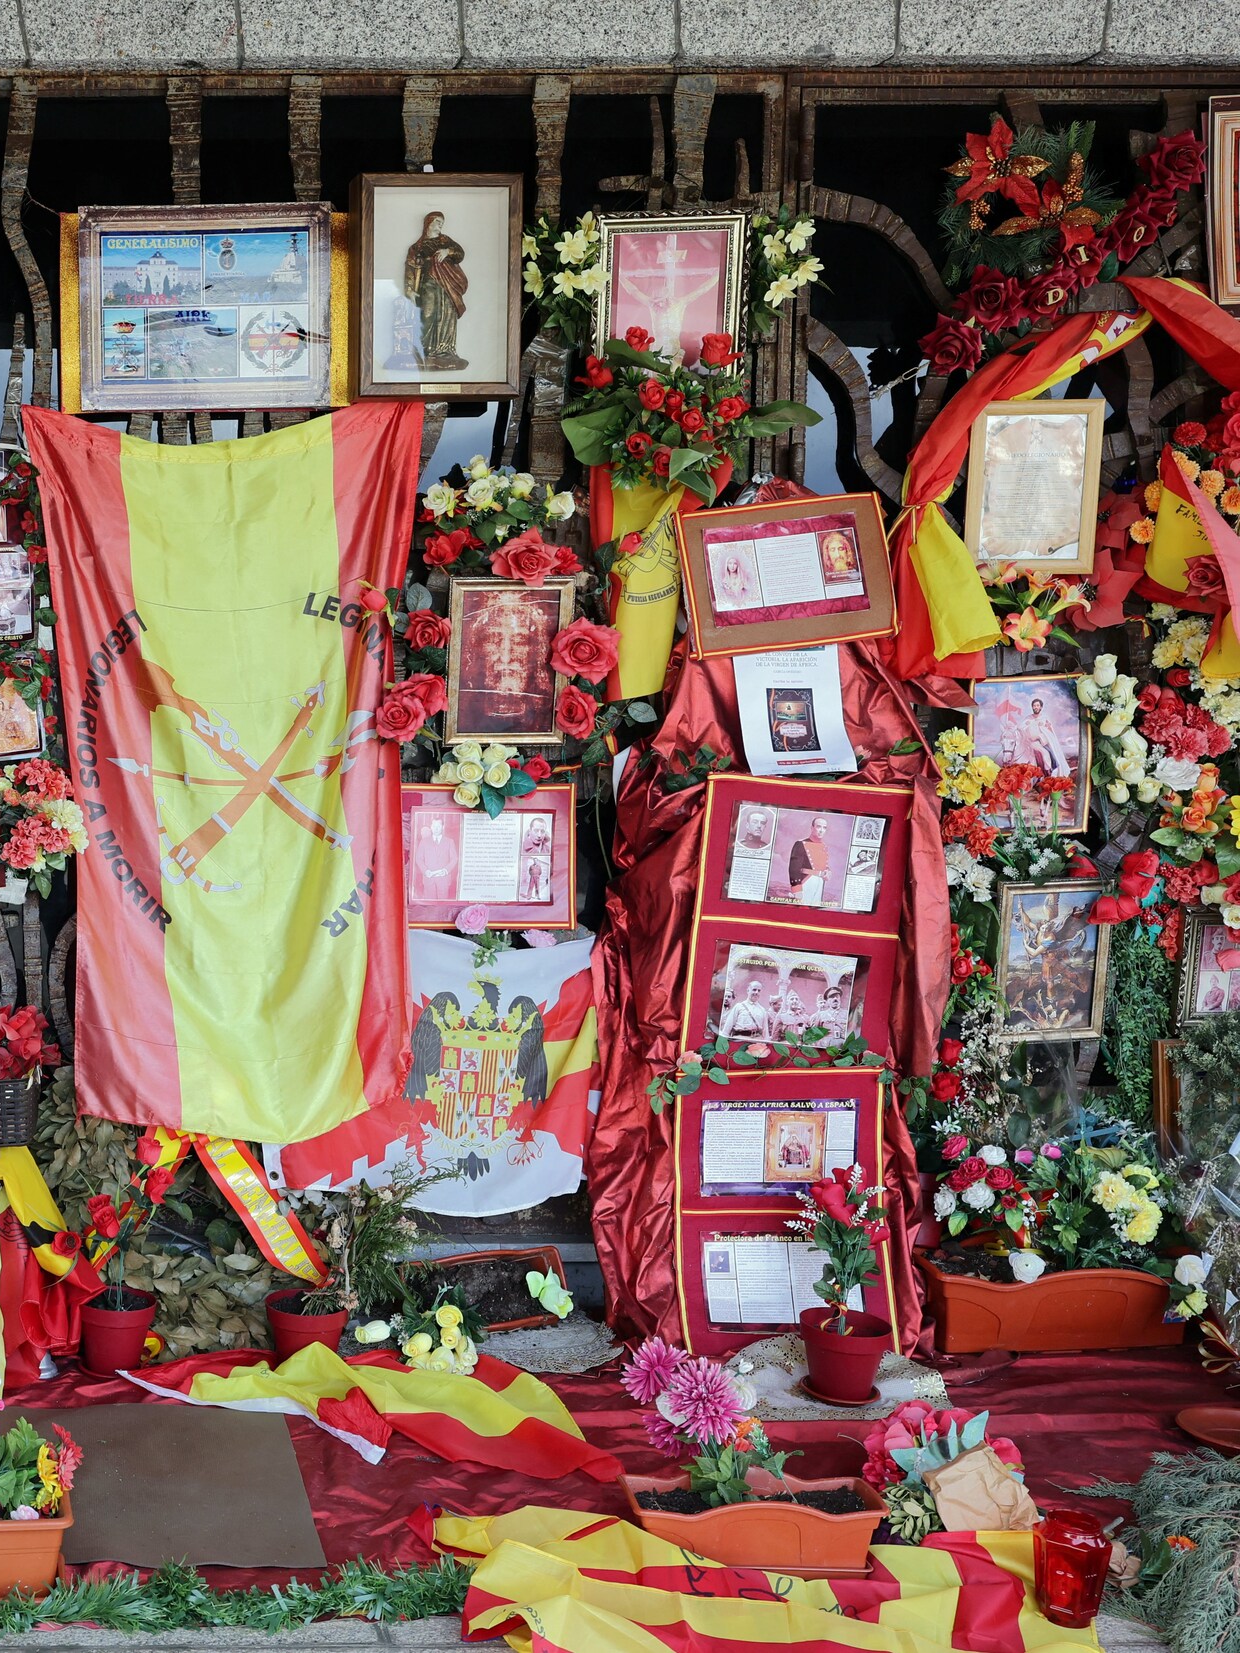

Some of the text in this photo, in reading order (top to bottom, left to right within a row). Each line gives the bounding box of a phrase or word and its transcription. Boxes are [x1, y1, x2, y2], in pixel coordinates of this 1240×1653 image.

[106, 237, 200, 250] GENERALISIMO
[125, 293, 180, 305] TIERRA
[76, 608, 173, 934] LEGIONARIOS A MORIR
[817, 1101, 824, 1109] A
[714, 1234, 753, 1242] Protectora
[754, 1234, 764, 1242] de
[764, 1233, 793, 1242] Franco
